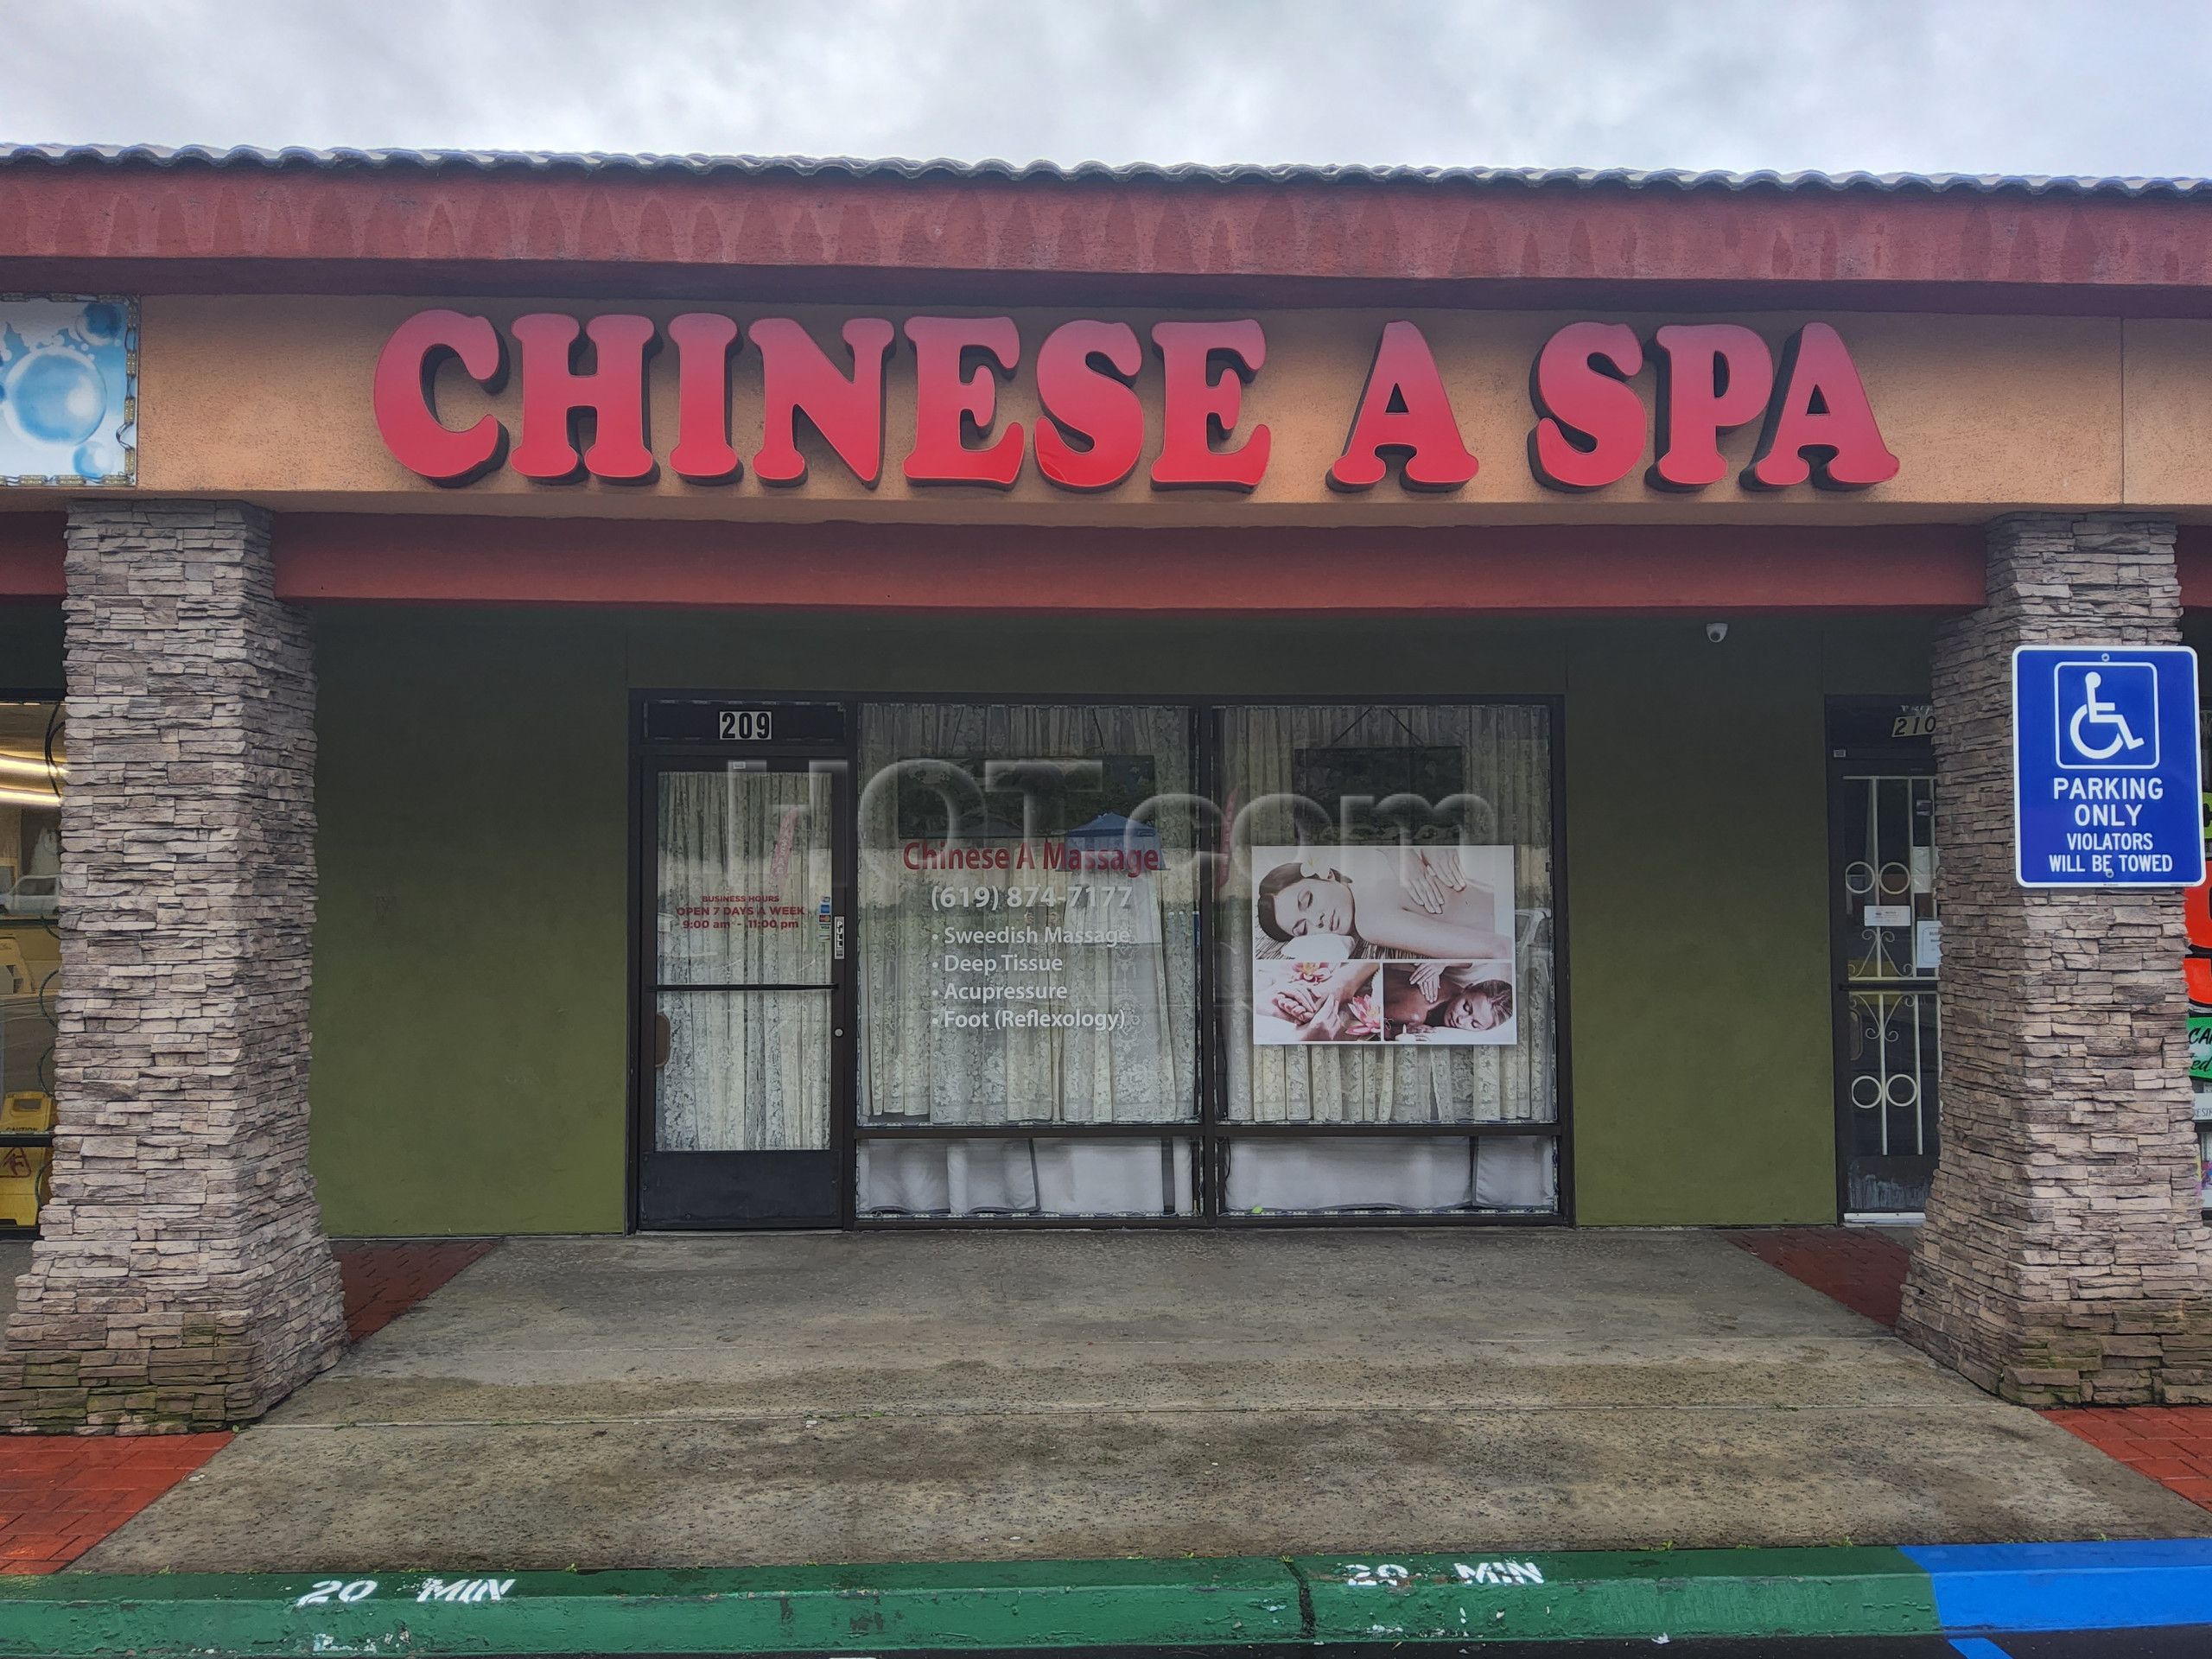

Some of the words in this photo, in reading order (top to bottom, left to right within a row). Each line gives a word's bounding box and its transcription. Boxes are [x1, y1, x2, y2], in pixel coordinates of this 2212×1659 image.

[373, 308, 1272, 490] CHINESE
[1326, 321, 1479, 492] A
[1527, 321, 1900, 493] SPA
[721, 712, 770, 739] 209
[1894, 715, 1936, 735] 210
[2053, 777, 2164, 800] PARKING
[2075, 804, 2143, 827] ONLY
[2066, 832, 2154, 851] VIOLATORS
[903, 842, 1011, 870] Chinese
[1016, 842, 1035, 870] A
[1043, 842, 1160, 878] Massage
[2049, 854, 2086, 873] WILL
[2092, 854, 2113, 873] BE
[2118, 854, 2173, 873] TOWED
[931, 886, 999, 911] (619)
[1007, 886, 1134, 908] 874-7177
[677, 907, 709, 916] OPEN
[713, 907, 721, 916] 7
[723, 906, 753, 916] DAYS
[756, 906, 766, 916] A
[769, 906, 804, 916] WEEK
[683, 919, 709, 929] 9:00
[747, 919, 778, 929] 11:00
[780, 921, 799, 931] pm
[944, 926, 1038, 944] Sweedish
[1044, 926, 1131, 948] Massage
[944, 955, 997, 976] Deep
[1001, 954, 1063, 971] Tissue
[944, 983, 1068, 1003] Acupressure
[944, 1010, 989, 1028] Foot
[995, 1009, 1125, 1031] (Reflexology)
[1345, 1564, 1408, 1586] 20
[1453, 1562, 1545, 1585] MIN
[296, 1580, 378, 1607] 20
[416, 1579, 517, 1604] MIN
